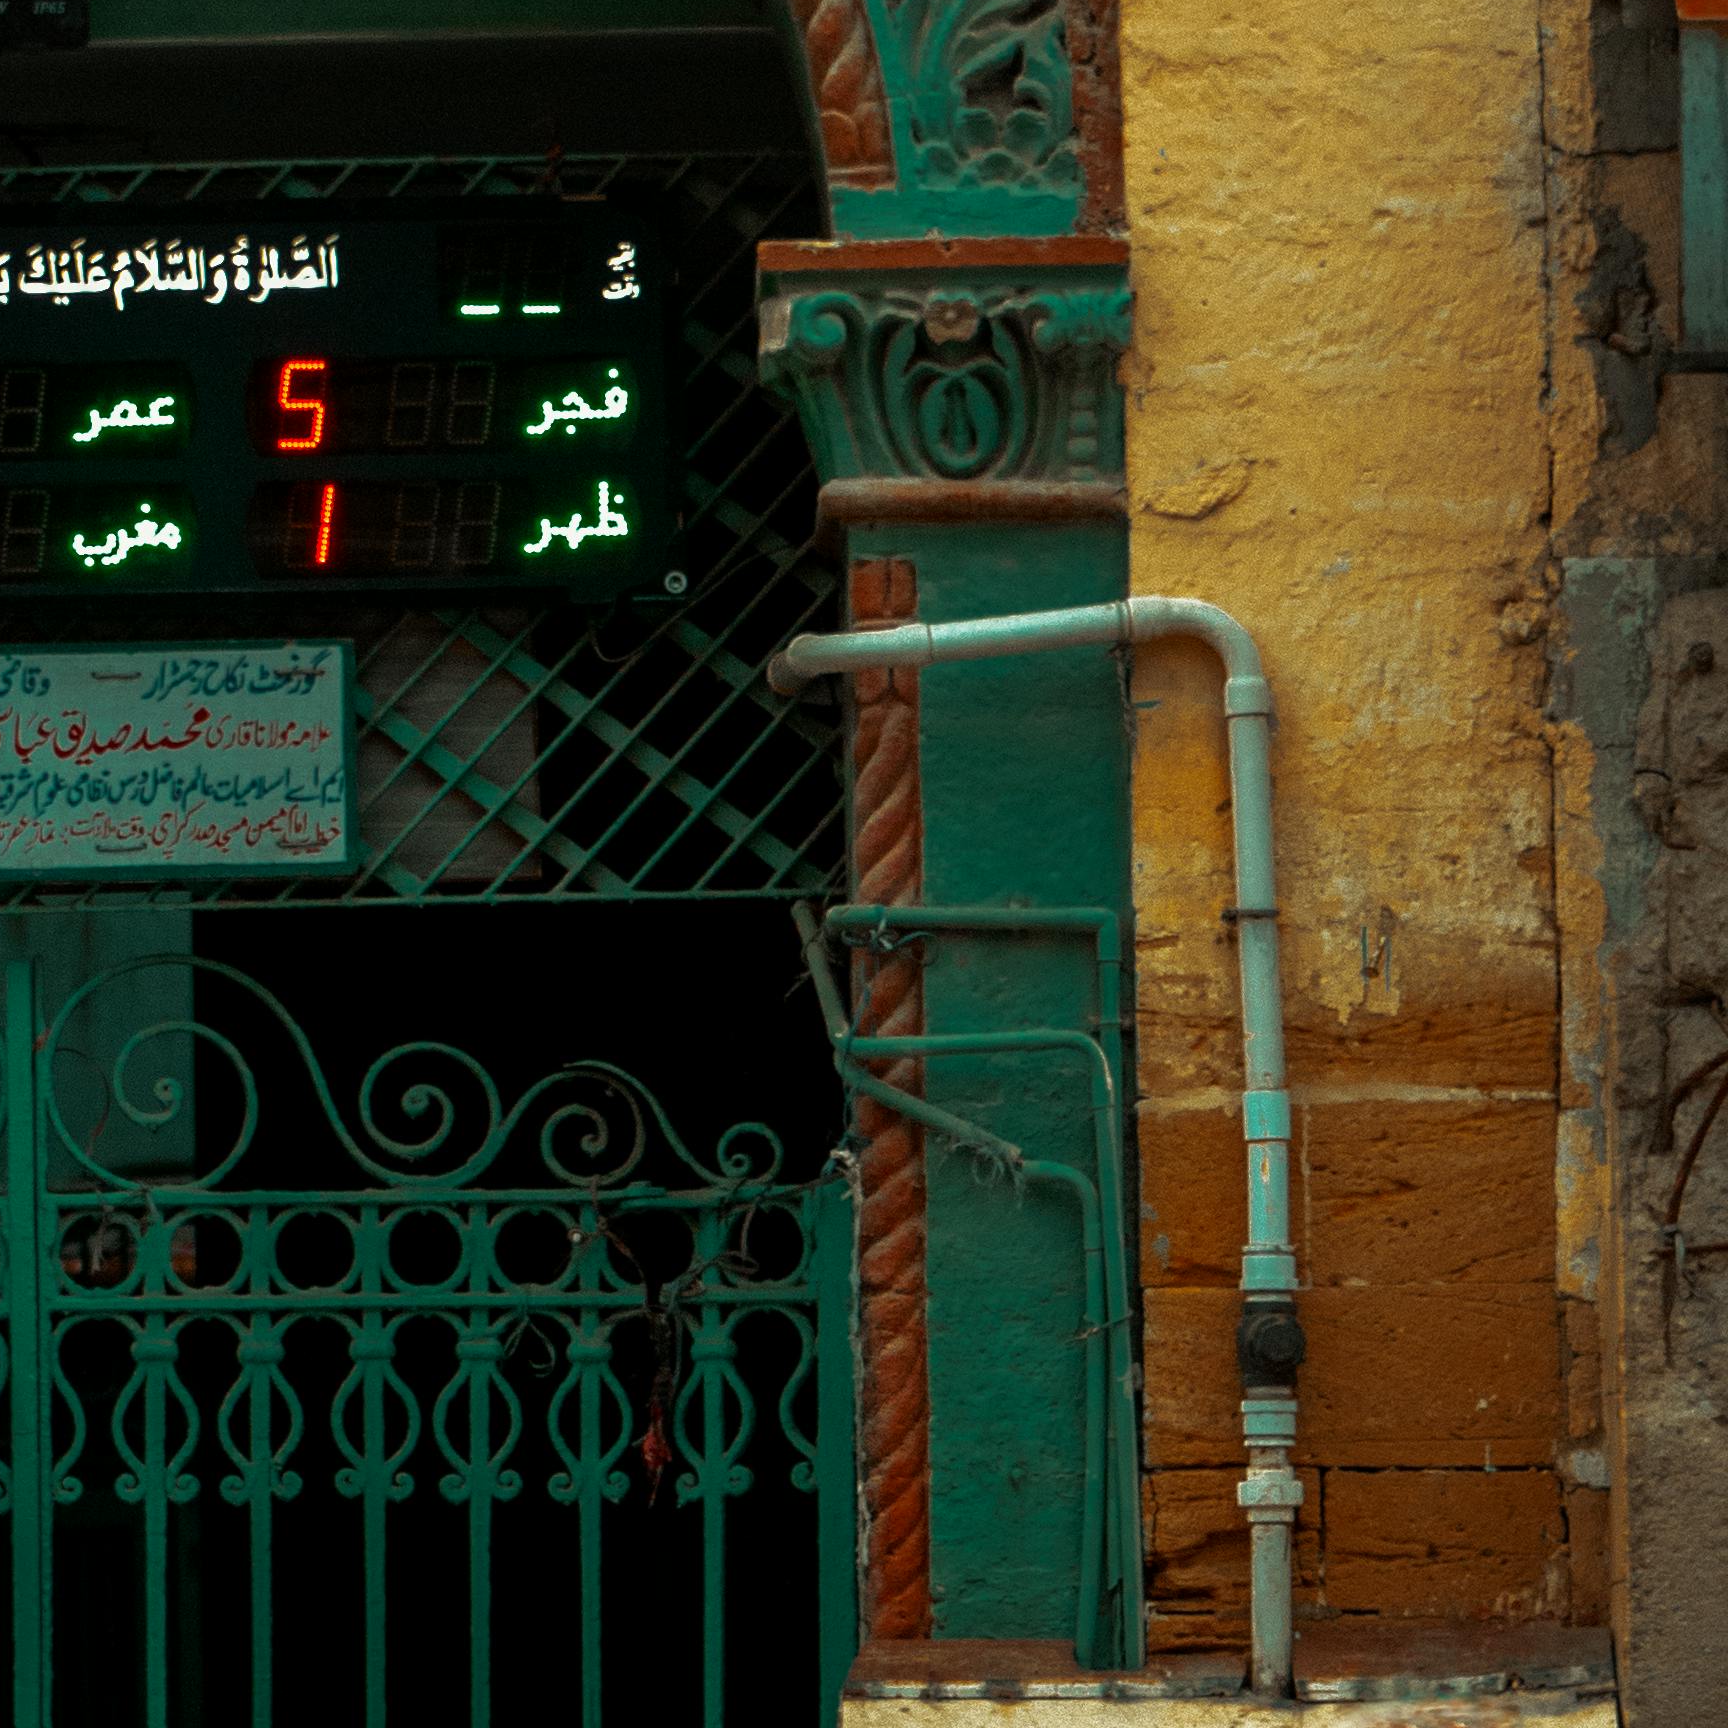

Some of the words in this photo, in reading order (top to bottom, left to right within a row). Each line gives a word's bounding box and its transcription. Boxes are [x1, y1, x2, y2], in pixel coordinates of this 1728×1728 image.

[32, 0, 65, 14] IP65
[277, 360, 324, 450] 5
[528, 368, 628, 436] فجر
[72, 502, 182, 568] مغرب
[316, 484, 335, 564] 1
[53, 708, 132, 765] صدیق
[205, 715, 254, 749] قاری
[254, 721, 295, 749] مولانا
